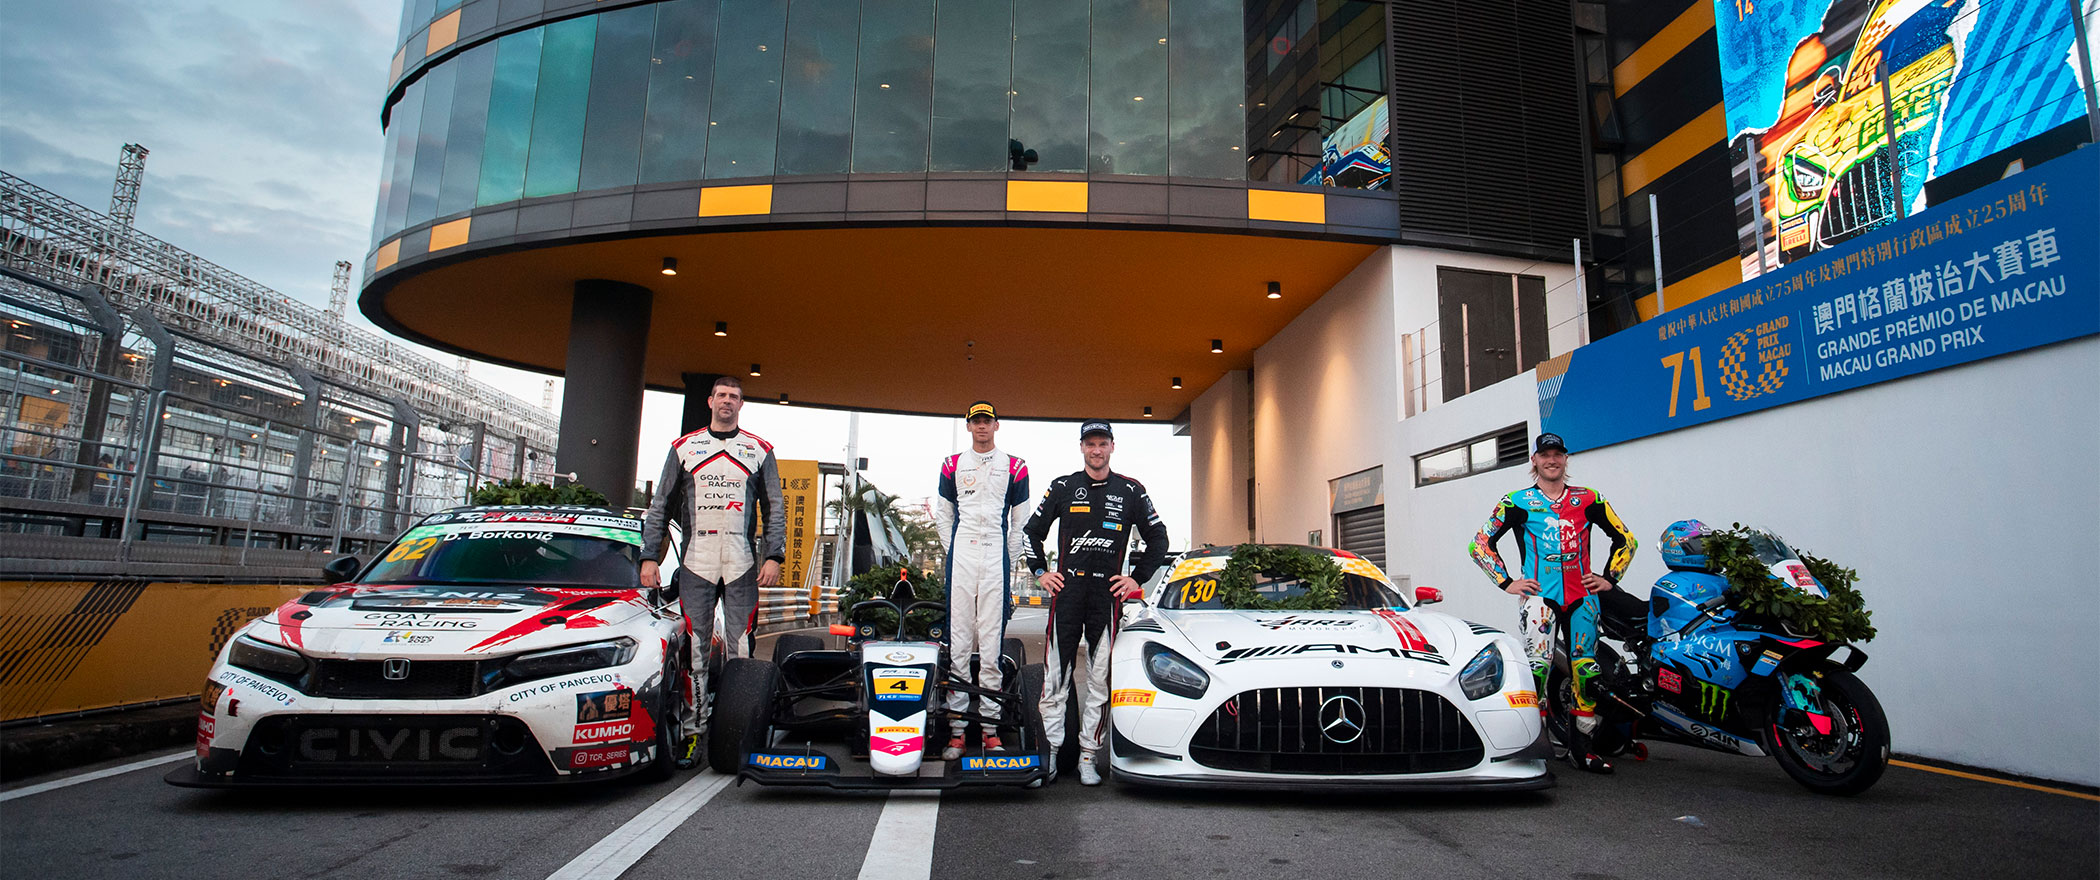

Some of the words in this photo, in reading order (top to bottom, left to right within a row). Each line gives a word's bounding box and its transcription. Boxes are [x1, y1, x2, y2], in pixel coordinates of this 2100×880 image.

[1812, 227, 2061, 336] 澳門格蘭披治大賽車
[1817, 327, 1881, 359] GRANDE
[1886, 307, 1955, 342] PRÉMIO
[1959, 298, 1987, 319] DE
[1992, 275, 2066, 313] MACAU
[1756, 316, 1789, 336] GRAND
[1757, 333, 1779, 350] PRIX
[1758, 343, 1791, 364] MACAU
[1820, 352, 1872, 382] MACAU
[1875, 339, 1936, 368] GRAND
[1941, 325, 1985, 352] PRIX
[1661, 346, 1711, 418] 71
[725, 501, 744, 512] R
[586, 516, 639, 525] KUMHO
[443, 532, 459, 542] D.
[468, 530, 554, 541] Borković
[1542, 532, 1578, 541] MGM
[385, 538, 437, 562] 62
[1180, 579, 1217, 604] 130
[380, 620, 478, 628] RACING
[1296, 644, 1450, 666] AMG
[220, 671, 238, 682] CITY
[236, 676, 249, 686] OF
[247, 679, 288, 702] PANCEVO
[510, 688, 537, 702] CITY
[541, 683, 557, 693] OF
[561, 674, 613, 689] PANCEVO
[890, 680, 909, 691] 4
[1112, 692, 1152, 706] PIRELLI
[1509, 693, 1538, 705] PIREL
[575, 723, 632, 740] KUMHO
[300, 727, 479, 761] CIVIC
[589, 750, 627, 762] TCR_SERIES
[756, 755, 820, 768] MACAU
[969, 757, 1031, 769] MACAU
